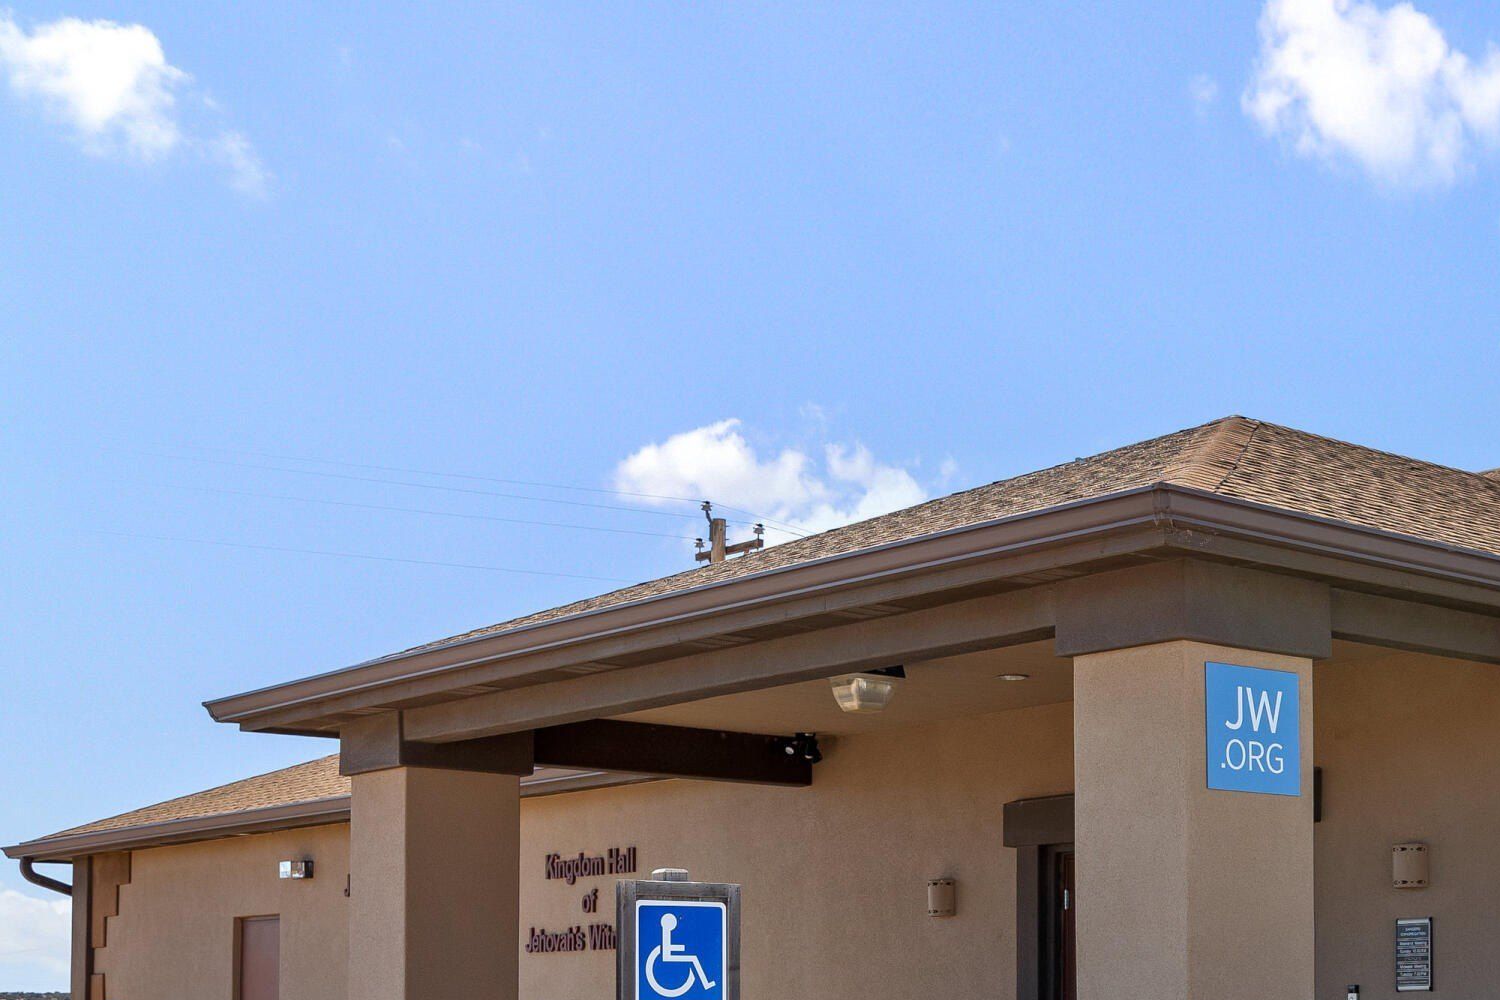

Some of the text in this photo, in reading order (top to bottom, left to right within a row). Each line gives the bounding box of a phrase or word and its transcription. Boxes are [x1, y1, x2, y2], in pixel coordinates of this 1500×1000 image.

[1225, 686, 1283, 734] JW
[1220, 738, 1284, 774] .ORG
[545, 847, 637, 885] Kingdom Hall
[582, 888, 598, 913] of
[525, 926, 586, 953] Jehovah's
